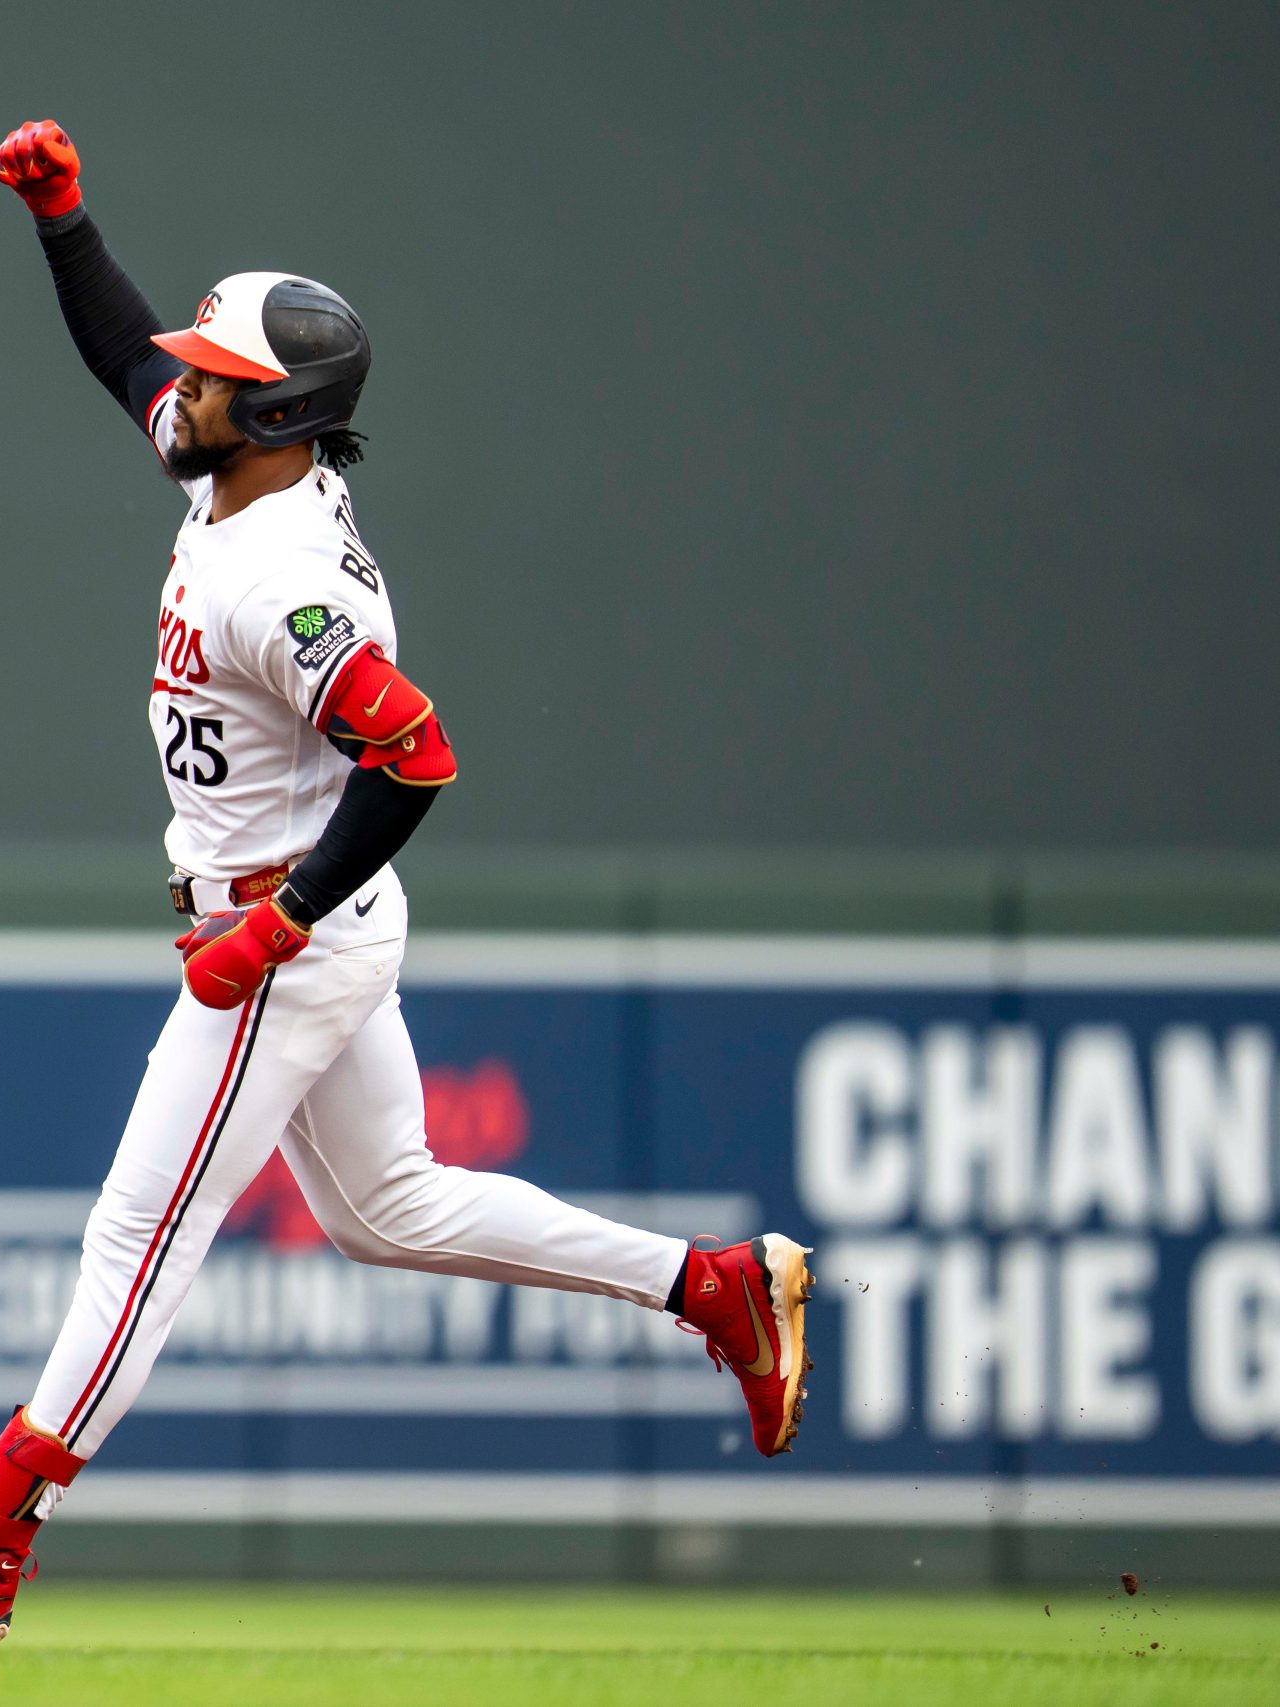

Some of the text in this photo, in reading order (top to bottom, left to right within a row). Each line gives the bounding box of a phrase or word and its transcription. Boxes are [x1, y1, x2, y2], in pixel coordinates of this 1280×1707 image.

[299, 618, 350, 664] securian
[312, 631, 350, 664] FINANCIAL
[166, 705, 229, 787] 25
[794, 1020, 1272, 1234] CHAN
[822, 1234, 1161, 1442] THE
